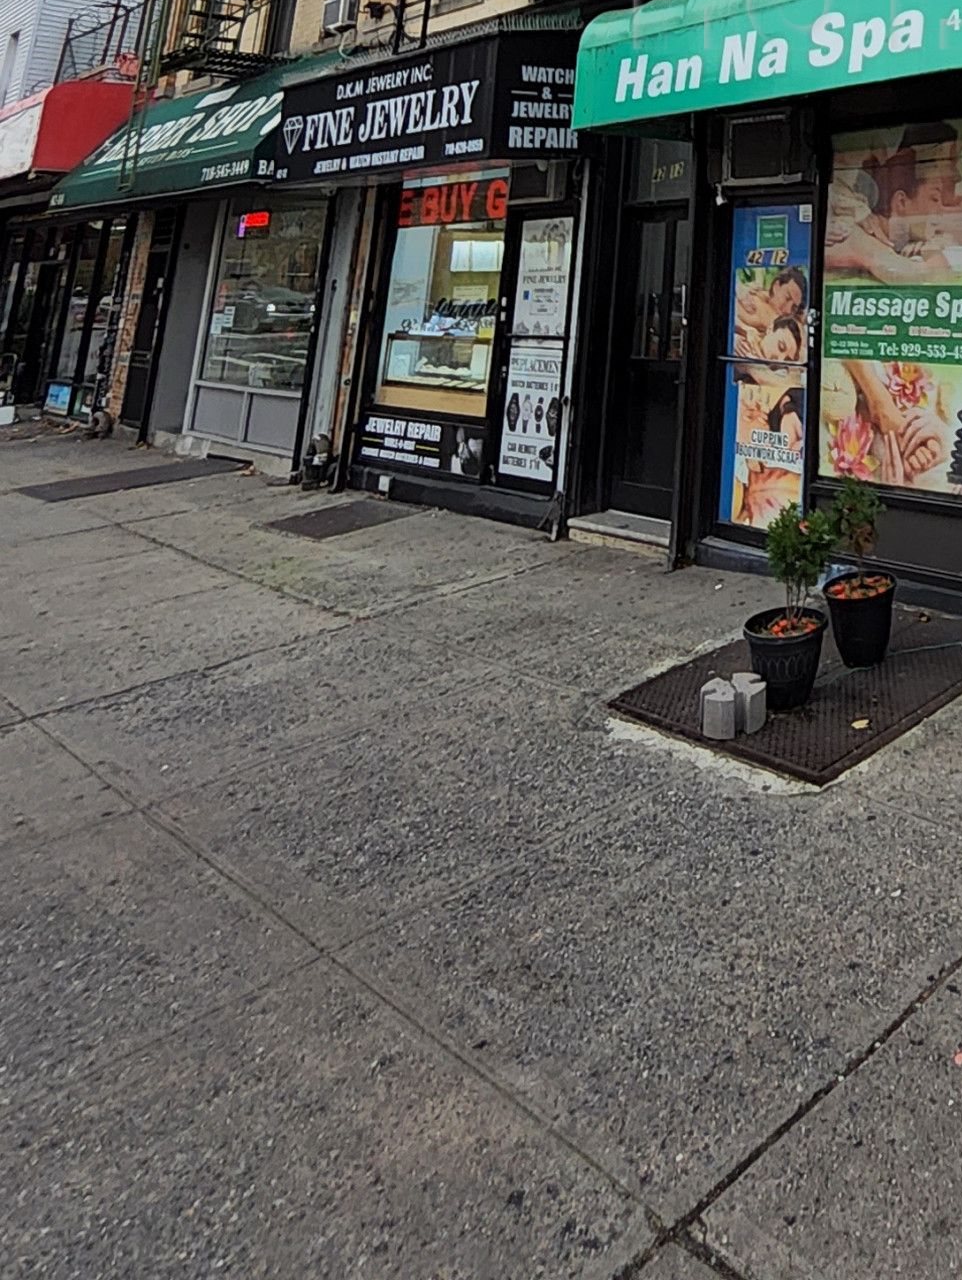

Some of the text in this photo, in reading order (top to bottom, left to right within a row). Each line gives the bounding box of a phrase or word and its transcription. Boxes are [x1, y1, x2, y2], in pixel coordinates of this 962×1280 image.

[614, 9, 925, 103] Han Na Spa
[366, 70, 409, 94] JEWELRY
[521, 65, 575, 85] WATCH
[541, 86, 553, 100] &
[186, 91, 284, 144] SHOP
[302, 80, 480, 152] FINE JEWELRY
[508, 126, 578, 149] REPAIR
[421, 182, 479, 224] BUY
[486, 178, 508, 219] G
[747, 250, 788, 265] 42 12
[831, 291, 929, 322] Massage
[878, 342, 899, 356] Tel:
[365, 417, 442, 442] JEWELRY REPAIR
[752, 430, 789, 447] CUPPING
